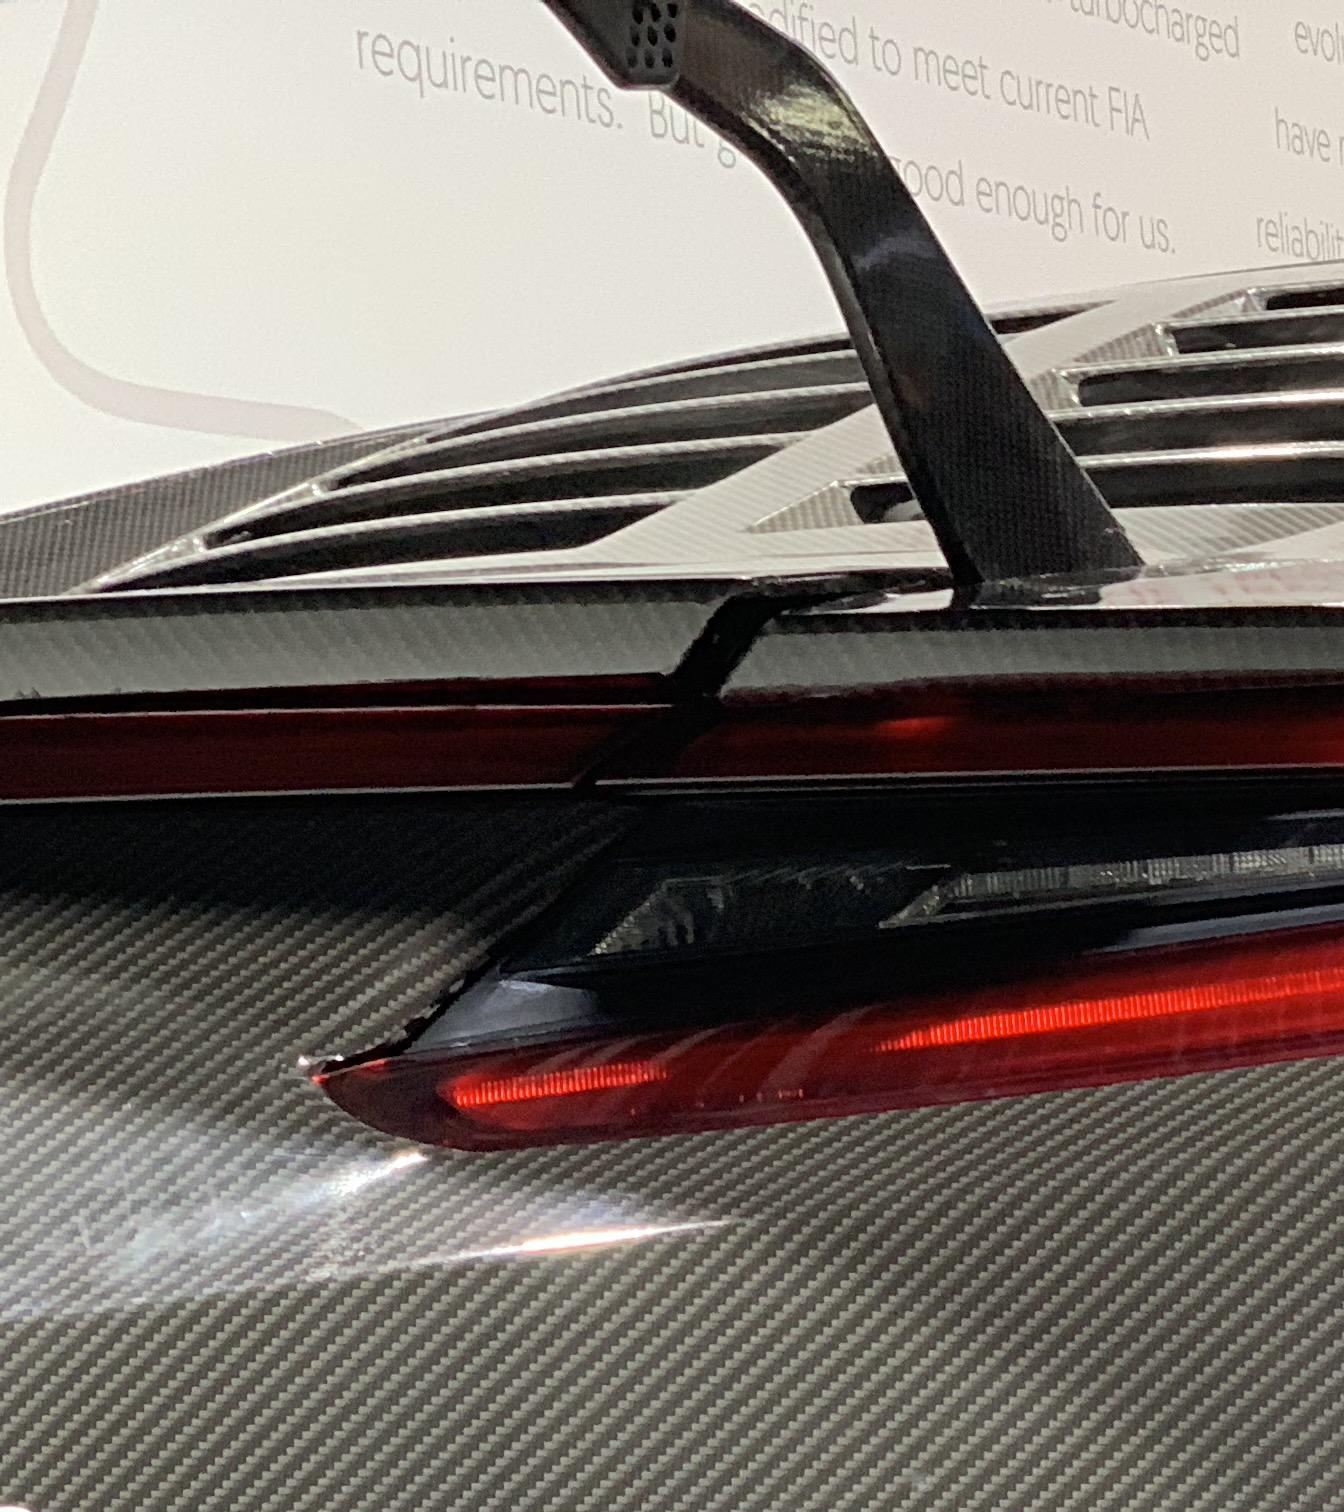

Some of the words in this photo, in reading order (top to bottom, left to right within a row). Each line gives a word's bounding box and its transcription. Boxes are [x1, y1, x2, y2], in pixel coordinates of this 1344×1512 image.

[1070, 0, 1240, 61] bocharged
[869, 26, 901, 76] to
[913, 46, 990, 100] meet
[1000, 70, 1101, 128] current
[1108, 86, 1149, 140] FIA
[357, 29, 623, 129] requirements.
[889, 156, 965, 206] ood
[976, 177, 1083, 242] enough
[1091, 192, 1130, 243] for
[1140, 215, 1176, 254] us.
[1275, 106, 1331, 162] have
